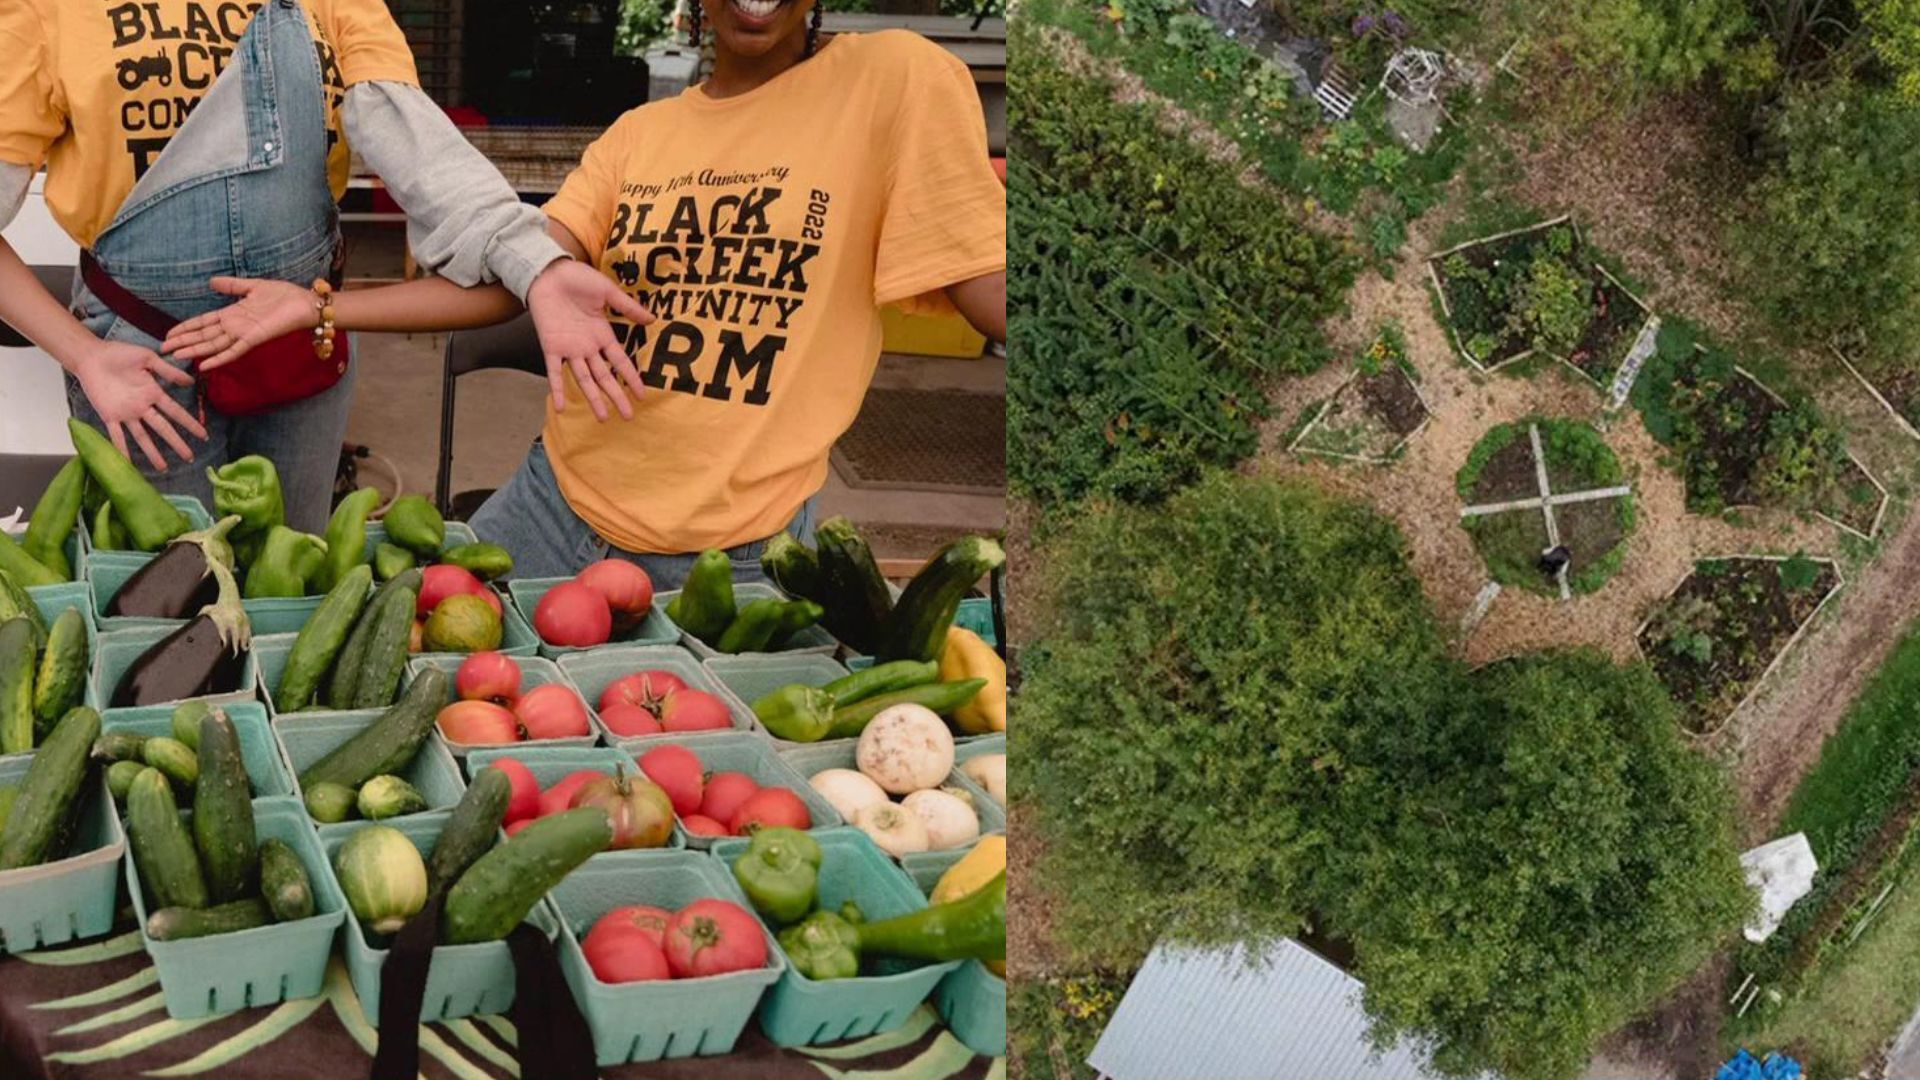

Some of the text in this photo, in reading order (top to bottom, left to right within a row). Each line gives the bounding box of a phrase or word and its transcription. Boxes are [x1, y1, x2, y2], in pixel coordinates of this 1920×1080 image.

[107, 2, 263, 48] BLAC
[607, 187, 782, 250] BLACK
[801, 189, 830, 240] 2022
